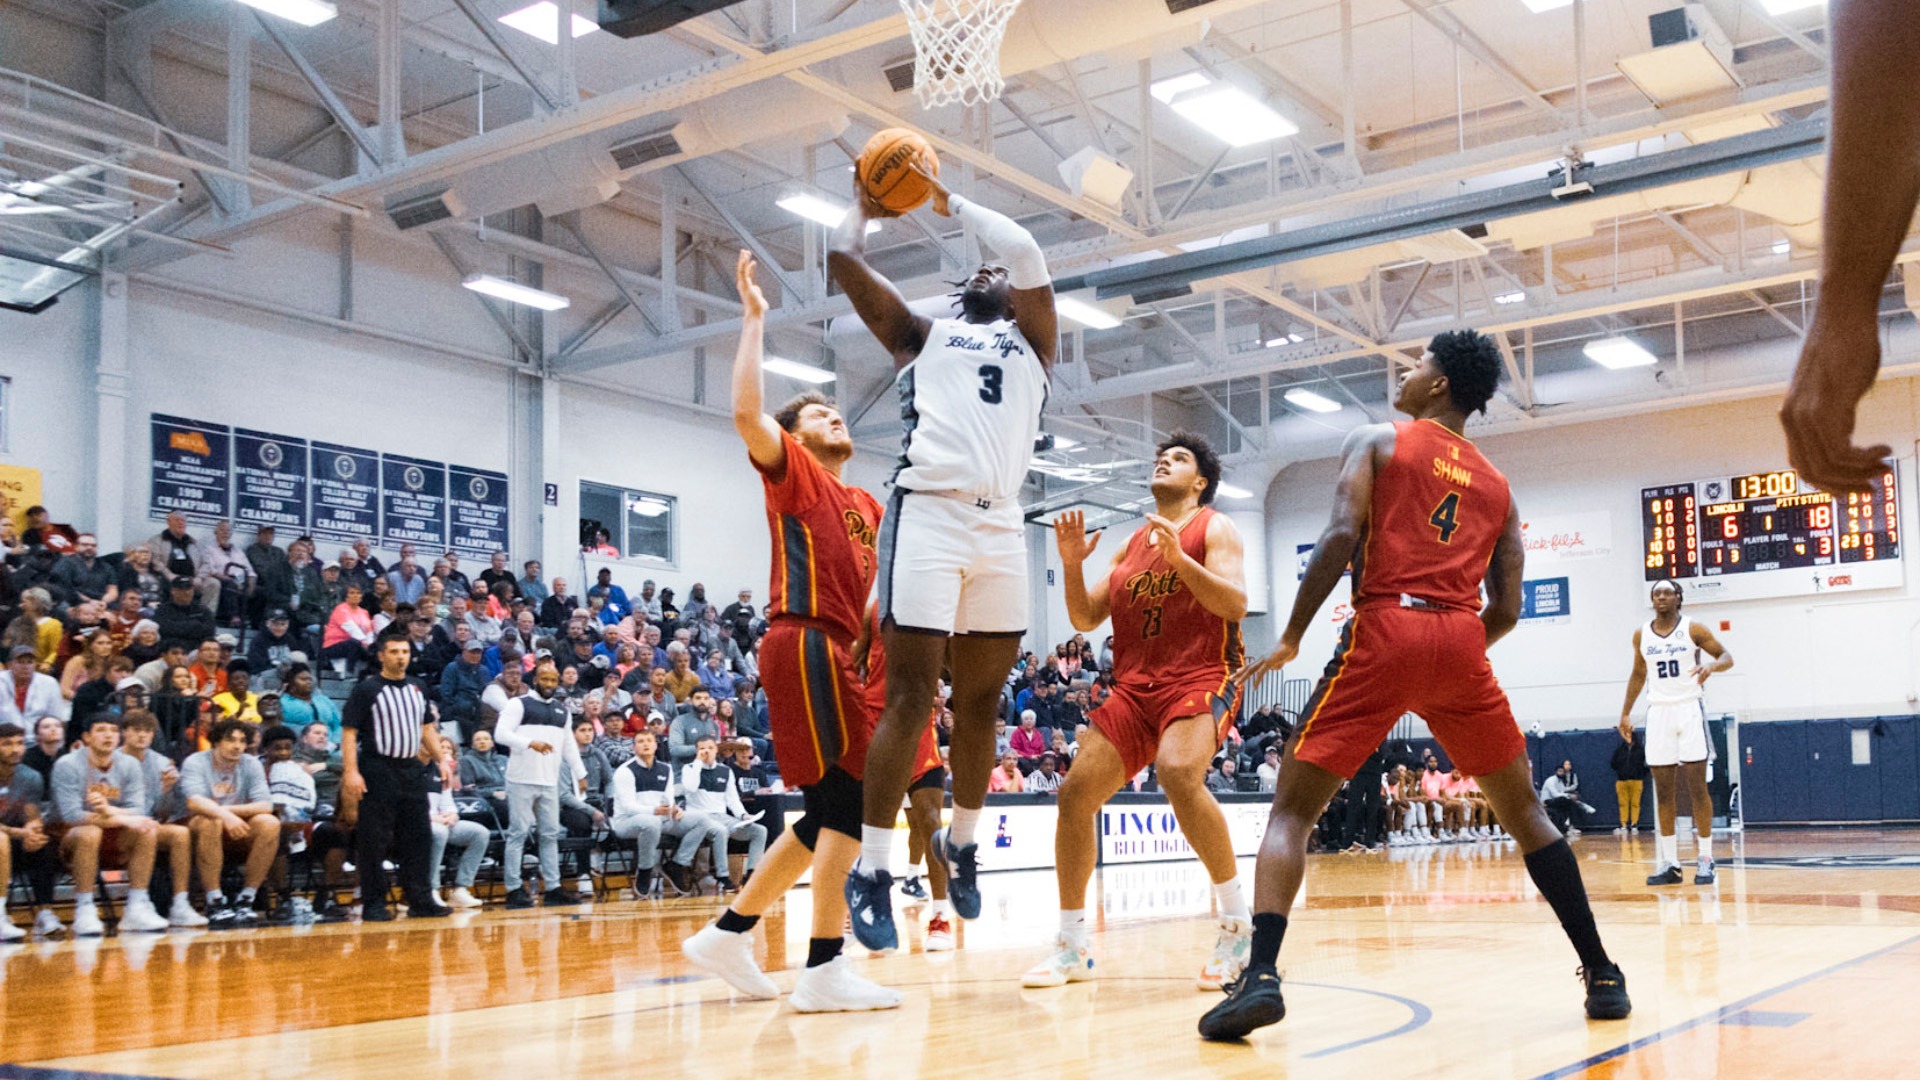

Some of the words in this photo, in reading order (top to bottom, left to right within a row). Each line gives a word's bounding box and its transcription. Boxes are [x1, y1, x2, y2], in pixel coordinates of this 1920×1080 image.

[872, 144, 916, 185] Wilson
[945, 336, 985, 351] Blue
[978, 364, 1003, 405] 3
[1432, 457, 1472, 489] SHAW
[1883, 473, 1894, 486] 0
[548, 485, 556, 499] 2
[1664, 488, 1675, 496] FLS
[1678, 486, 1690, 494] PTS
[1740, 471, 1796, 499] 13:00
[1885, 487, 1894, 500] 3
[157, 496, 222, 513] CHAMPIONS
[975, 498, 991, 510] LU
[1664, 498, 1674, 512] 0
[1685, 496, 1694, 510] 0
[1706, 503, 1746, 516] LINCOLN
[1752, 504, 1777, 513] PERIOD
[1847, 506, 1859, 518] 4
[1862, 504, 1872, 517] 0
[1885, 501, 1895, 515] 0
[240, 508, 300, 525] CHAMPIONS
[333, 509, 356, 521] 2001
[1429, 490, 1461, 546] 4
[1656, 513, 1662, 525] 1
[1665, 511, 1675, 525] 0
[1685, 509, 1695, 523] 2
[1723, 515, 1739, 538] 6
[1765, 514, 1773, 531] 1
[1808, 505, 1831, 528] 18
[316, 518, 372, 534] CHAMPIONS
[1654, 526, 1663, 541] 3
[1666, 525, 1675, 538] 0
[1686, 523, 1696, 536] 0
[1848, 519, 1859, 533] 5
[1867, 519, 1873, 530] 1
[1887, 516, 1896, 529] 3
[388, 528, 440, 542] CHAMPIONS
[1702, 540, 1724, 549] FOULS
[1743, 535, 1769, 545] PLAYER
[1771, 533, 1789, 542] FOUL
[1810, 529, 1833, 539] FOULS
[1841, 533, 1860, 549] 23
[1863, 532, 1874, 546] 0
[455, 536, 503, 551] CHAMPIONS
[1649, 539, 1663, 553] 10
[1666, 538, 1676, 552] 0
[1687, 536, 1696, 549] 0
[1715, 548, 1723, 564] 1
[1730, 549, 1740, 563] 3
[1794, 543, 1806, 555] 4
[1819, 536, 1832, 555] 3
[1646, 553, 1665, 568] 20
[1670, 553, 1676, 564] 1
[1687, 550, 1697, 563] 0
[1865, 547, 1874, 560] 3
[1671, 566, 1677, 577] 1
[1754, 562, 1780, 571] MATCH
[1125, 569, 1182, 608] Pitt
[1535, 583, 1560, 594] PROUD
[1535, 599, 1560, 608] LINCOLN
[1142, 605, 1162, 640] 23
[1646, 645, 1662, 656] Blue
[1656, 660, 1680, 679] 20
